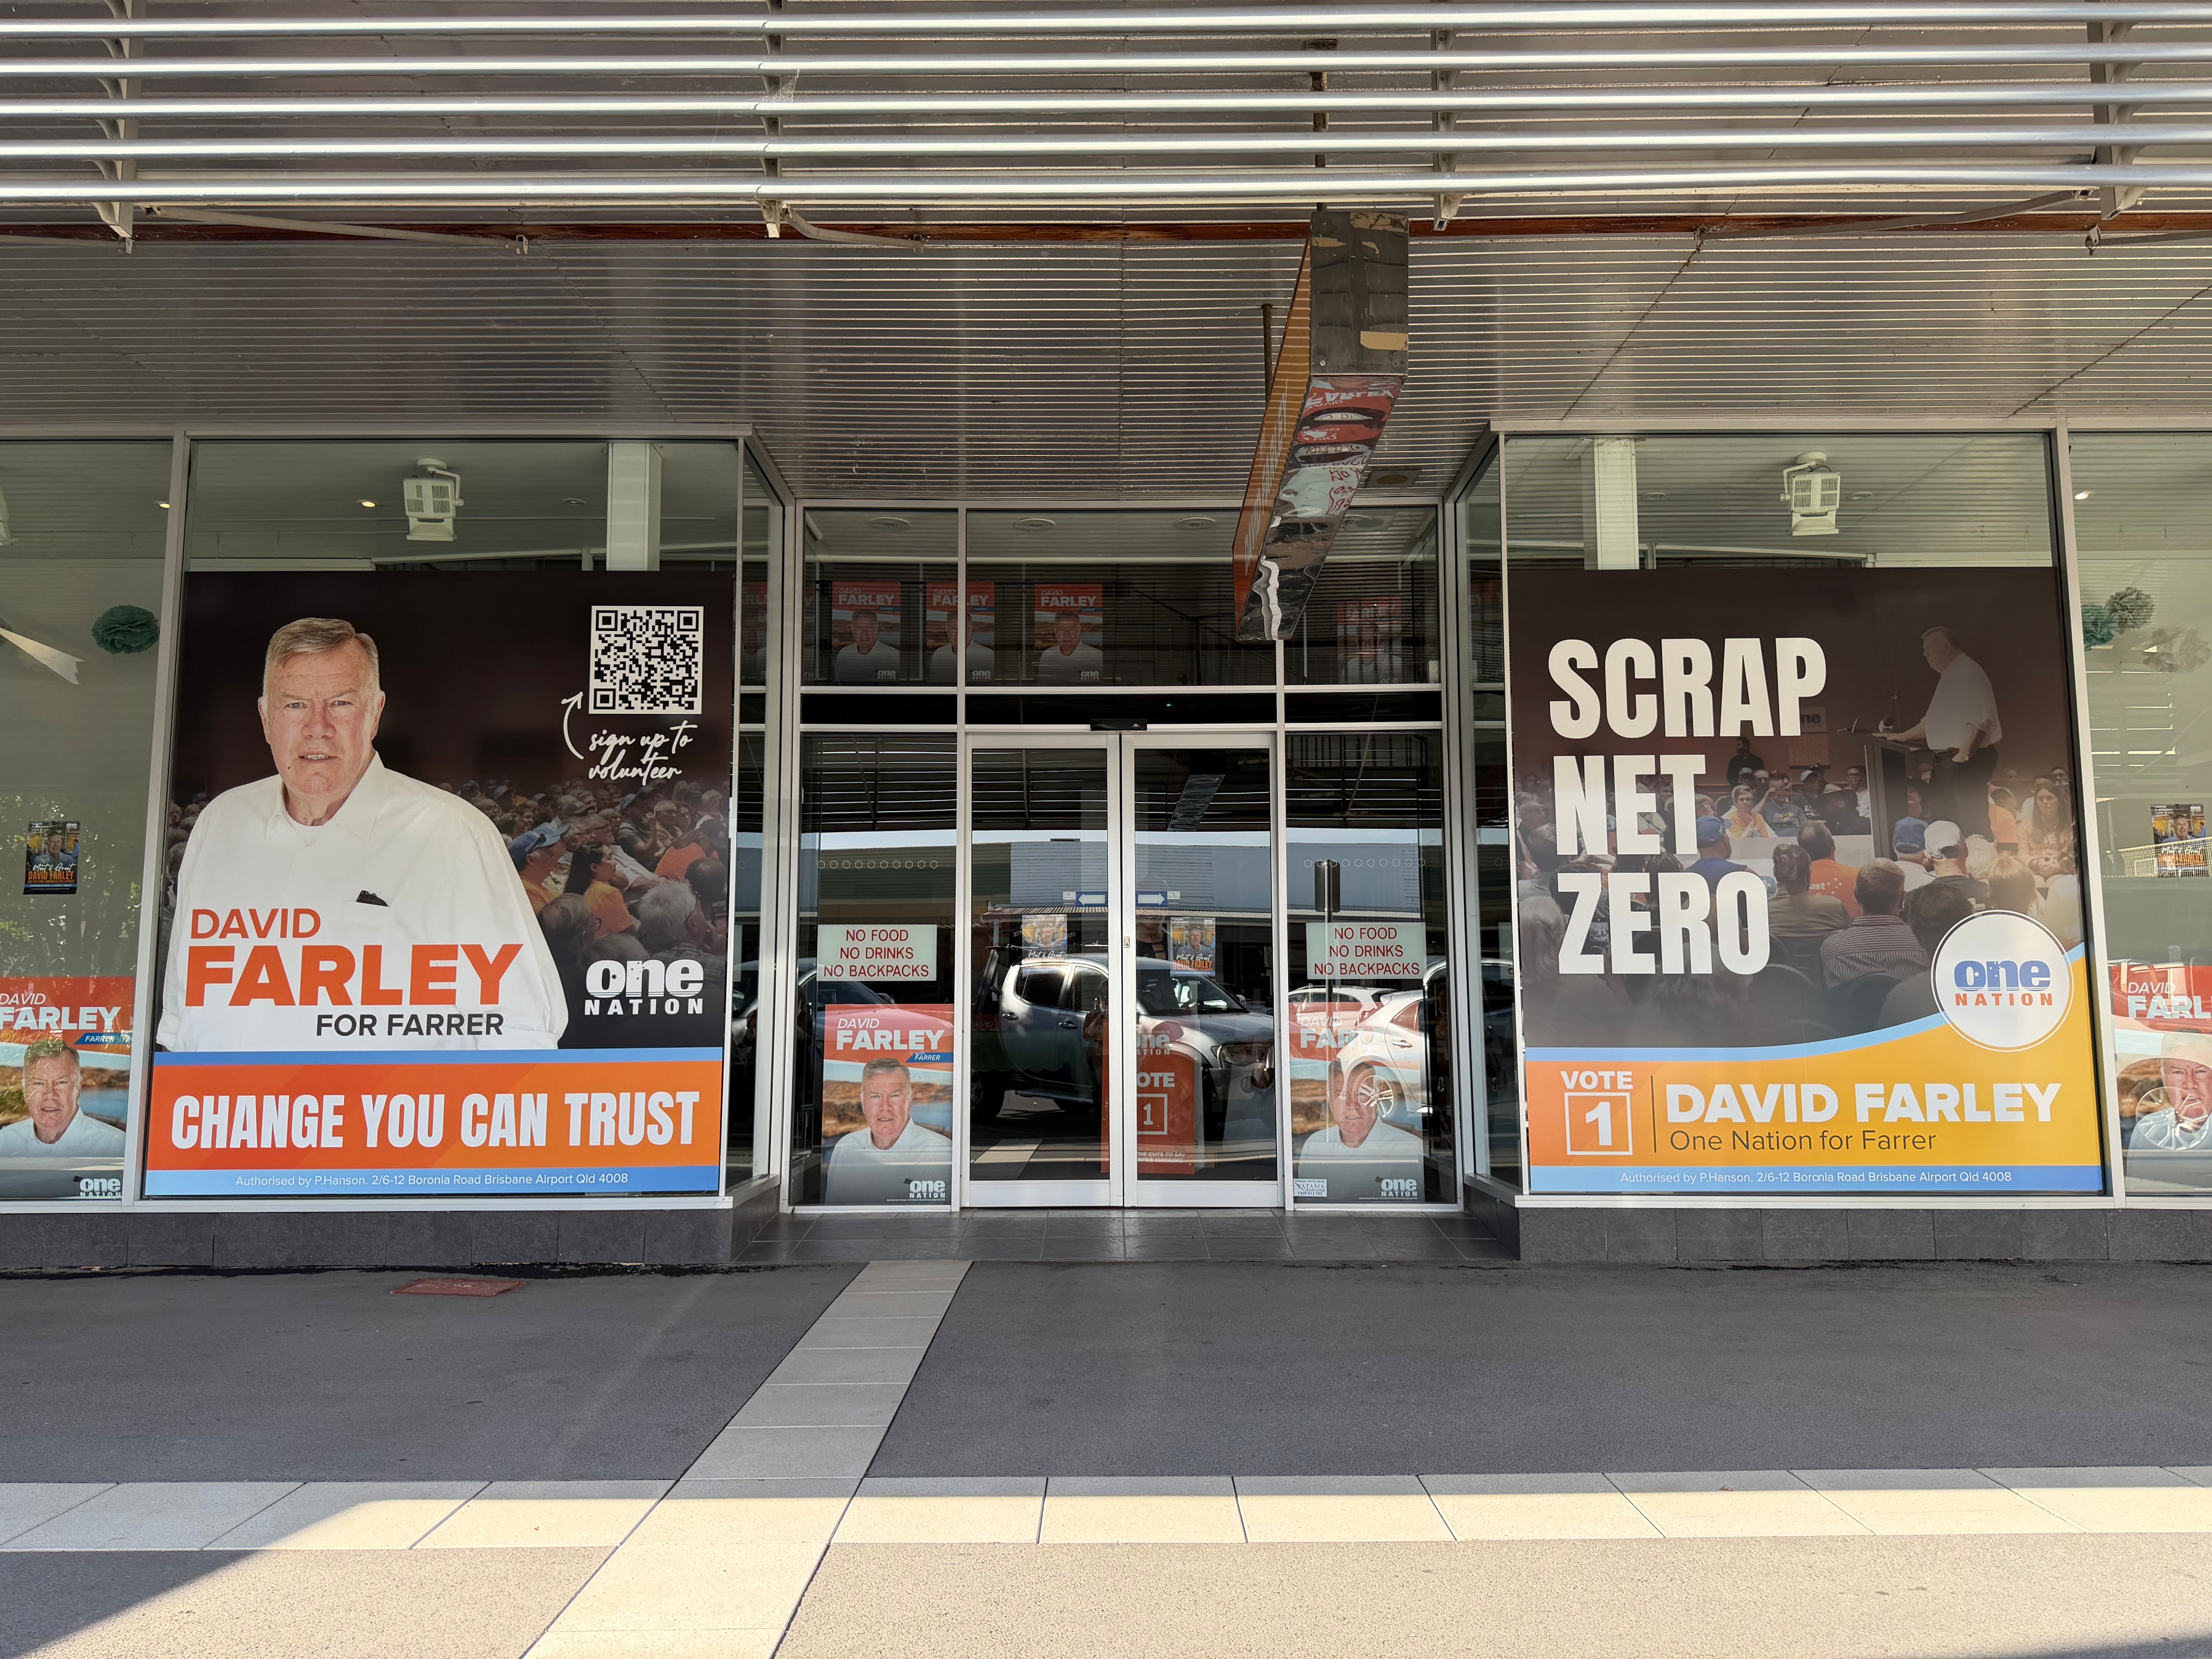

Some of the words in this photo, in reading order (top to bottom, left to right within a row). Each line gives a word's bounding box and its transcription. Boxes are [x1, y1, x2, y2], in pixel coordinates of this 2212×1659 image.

[839, 594, 895, 605] FARLEY
[1041, 596, 1097, 607] FARLEY
[1548, 637, 1827, 739] SCRAP
[1800, 714, 1821, 724] ne
[589, 730, 636, 765] sign
[640, 733, 669, 764] up
[670, 720, 698, 754] to
[588, 749, 682, 786] volunteer
[1553, 754, 1706, 855] NET
[33, 863, 50, 872] Meet
[55, 862, 76, 872] Greet
[28, 872, 48, 880] DAVID
[50, 871, 74, 879] FARLEY
[191, 908, 321, 939] DAVID
[1557, 871, 1770, 975] ZERO
[846, 929, 865, 941] NO
[871, 929, 908, 941] FOOD
[1335, 927, 1354, 940] NO
[1360, 927, 1397, 940] FOOD
[840, 947, 860, 960] NO
[865, 947, 914, 960] DRINKS
[1329, 945, 1349, 957] NO
[1355, 945, 1403, 957] DRINKS
[185, 944, 524, 1006] FARLEY
[824, 965, 844, 977] NO
[849, 964, 929, 977] BACKPACKS
[1314, 963, 1334, 976] NO
[1339, 962, 1419, 976] BACKPACKS
[1953, 959, 2051, 992] one
[585, 960, 703, 998] one
[2128, 982, 2176, 994] DAVID
[0, 993, 46, 1005] DAVID
[1955, 993, 2053, 1006] NATION
[585, 999, 703, 1016] NATION
[2128, 995, 2212, 1019] FARL
[0, 1006, 122, 1030] FARLEY
[837, 1018, 879, 1029] DAVID
[1300, 1017, 1342, 1027] DAVID
[316, 1014, 377, 1037] FOR
[387, 1014, 504, 1036] FARRER
[837, 1029, 945, 1050] FARLEY
[1137, 1072, 1175, 1087] OTE
[1560, 1071, 1633, 1090] VOTE
[1667, 1084, 1838, 1123] DAVID
[1856, 1083, 2061, 1122] FARLEY
[172, 1094, 344, 1149] CHANGE
[362, 1094, 444, 1148] YOU
[461, 1093, 548, 1147] CAN
[565, 1092, 700, 1146] TRUST
[1143, 1103, 1153, 1125] 1
[1585, 1102, 1612, 1147] 1
[1670, 1130, 1722, 1152] One
[1732, 1129, 1813, 1151] Nation
[1820, 1129, 1854, 1151] for
[1863, 1129, 1936, 1151] Farrer
[236, 1176, 294, 1186] Authorised
[298, 1175, 311, 1187] by
[315, 1175, 368, 1185] P.Hanson.
[372, 1175, 404, 1185] 2/6-12
[409, 1175, 450, 1184] Boronia
[453, 1175, 481, 1184] Road
[485, 1174, 532, 1184] Brisbane
[535, 1174, 573, 1186] Airport
[576, 1174, 595, 1183] Qld
[599, 1173, 628, 1183] 4008
[1621, 1173, 1679, 1182] Authorised
[1684, 1173, 1696, 1184] by
[1700, 1173, 1753, 1182] P.Hanson.
[1757, 1172, 1789, 1182] 2/6-12
[1794, 1172, 1833, 1182] Boronia
[1838, 1172, 1864, 1181] Road
[1869, 1172, 1916, 1181] Brisbane
[1919, 1172, 1957, 1183] Airport
[1960, 1171, 1978, 1181] Qld
[1982, 1171, 2012, 1181] 4008
[80, 1178, 121, 1192] one
[910, 1180, 945, 1193] one
[1381, 1179, 1417, 1191] one
